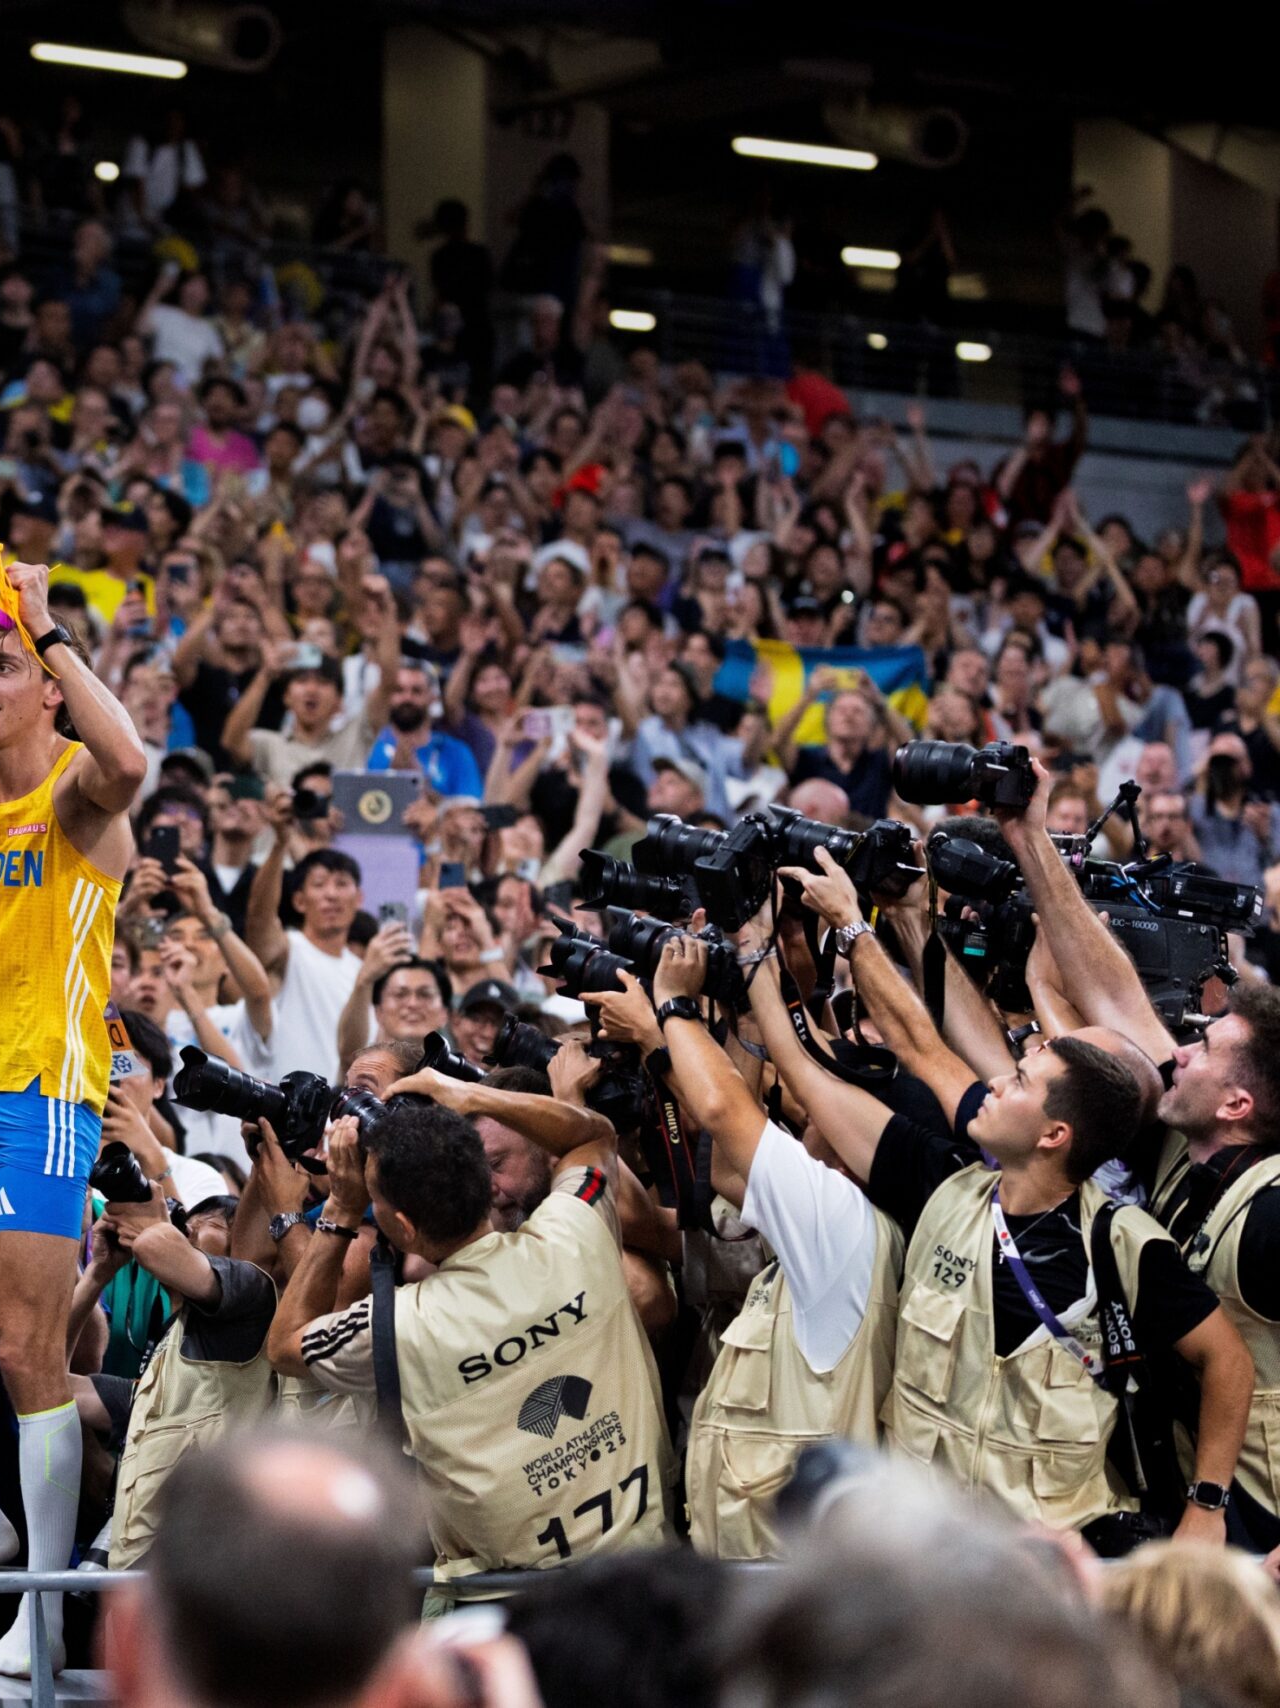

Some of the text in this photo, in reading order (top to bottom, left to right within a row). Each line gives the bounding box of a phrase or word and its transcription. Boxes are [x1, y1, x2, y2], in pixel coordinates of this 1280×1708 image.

[8, 824, 47, 836] BAUHAUS
[664, 1102, 680, 1144] Canon
[934, 1245, 977, 1272] SONY
[934, 1262, 966, 1288] 129
[458, 1291, 588, 1384] SONY
[1111, 1301, 1136, 1351] SONY
[523, 1411, 619, 1475] WORLD ATHLETICS
[528, 1423, 623, 1486] CHAMPIONSHIPS
[605, 1435, 627, 1454] 25
[537, 1464, 648, 1559] 177
